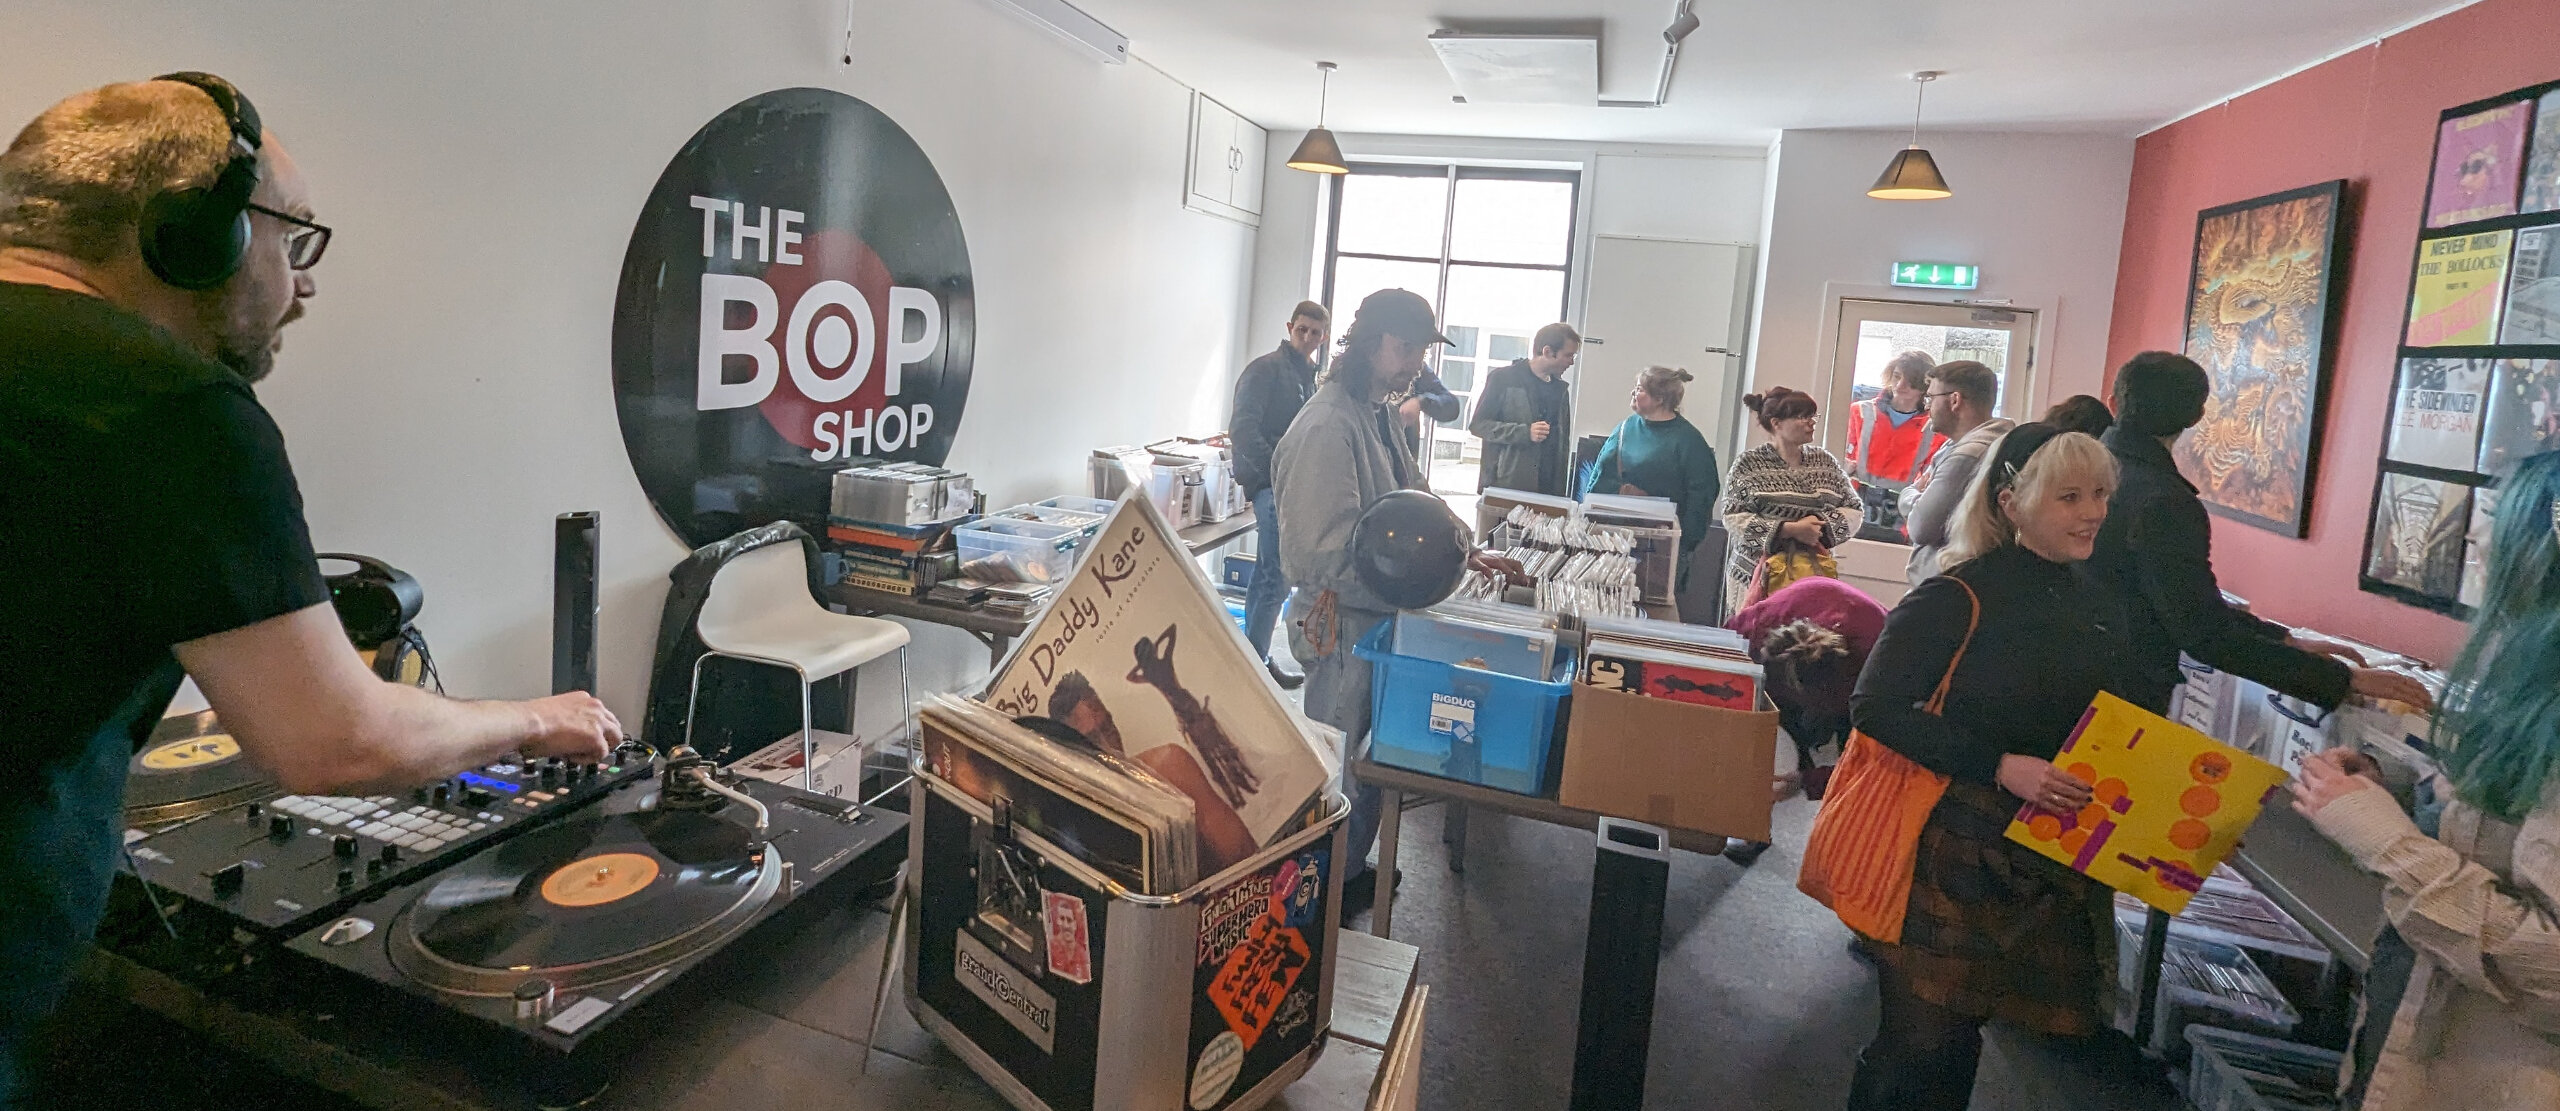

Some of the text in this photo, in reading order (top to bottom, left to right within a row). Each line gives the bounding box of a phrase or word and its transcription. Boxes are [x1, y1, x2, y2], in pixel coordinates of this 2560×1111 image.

[690, 195, 805, 265] THE
[2431, 233, 2498, 256] NEVER MIND
[697, 273, 941, 411] BOP
[810, 403, 934, 462] SHOP
[2420, 413, 2473, 433] MORGAN
[996, 526, 1145, 717] Big Daddy Kane
[1213, 922, 1252, 960] MUSIC
